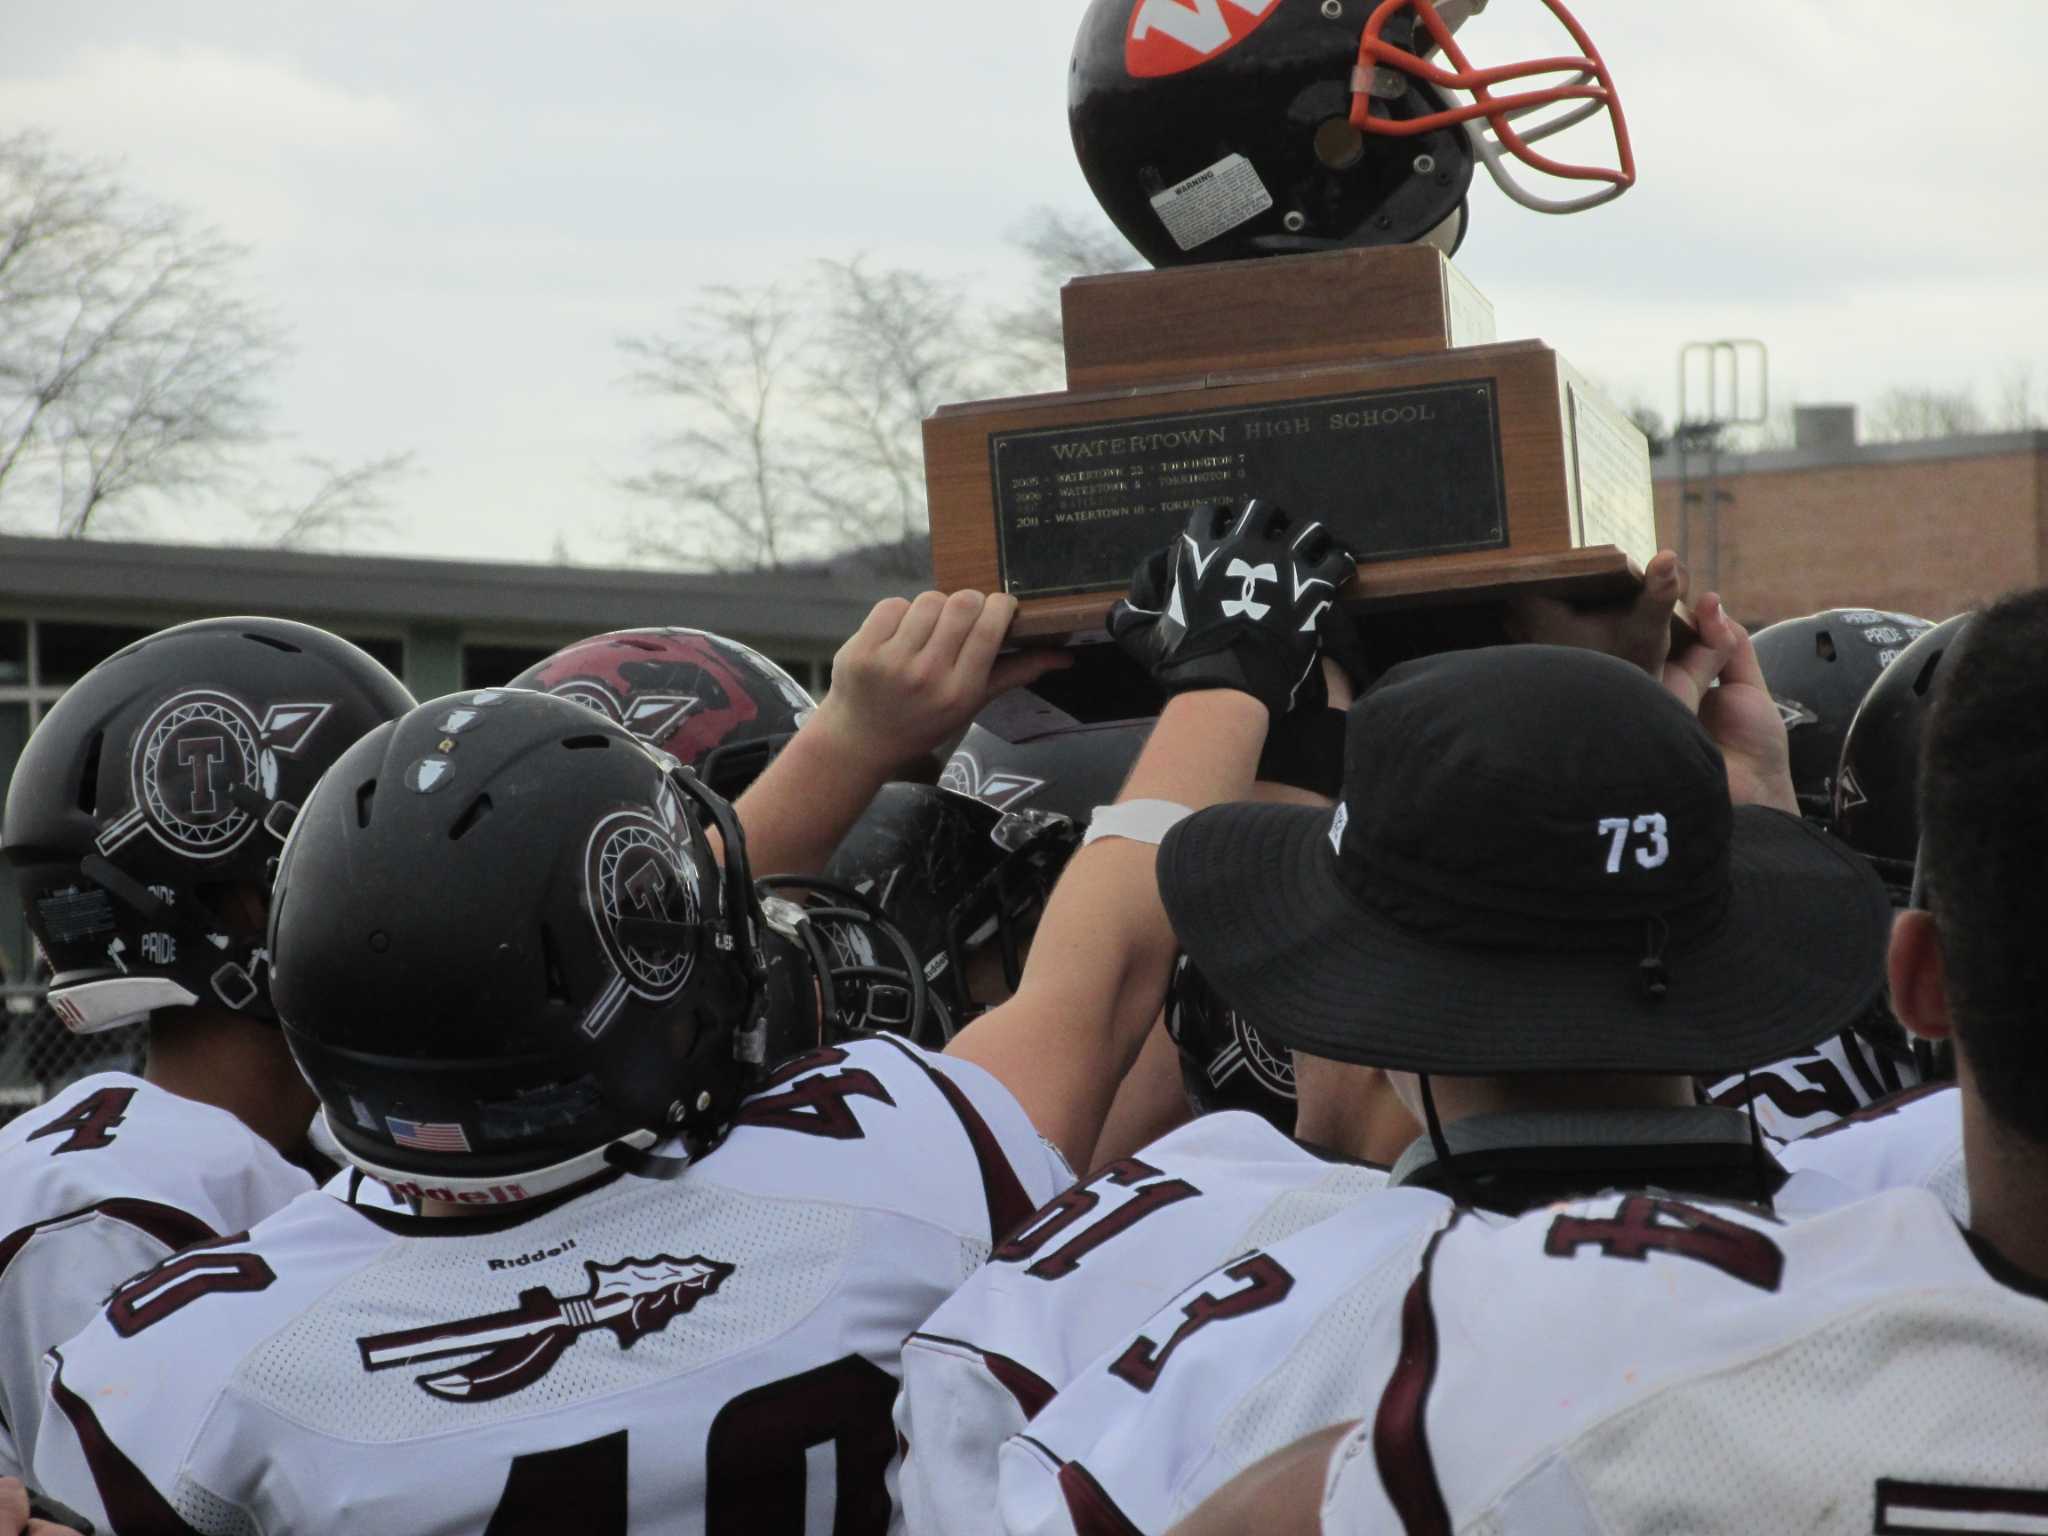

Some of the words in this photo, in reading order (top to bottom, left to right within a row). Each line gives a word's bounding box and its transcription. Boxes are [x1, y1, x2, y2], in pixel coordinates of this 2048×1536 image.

[1174, 170, 1214, 195] WARNING
[1051, 426, 1226, 460] WATERTOWN
[1244, 416, 1312, 440] HIGH
[1329, 404, 1436, 430] SCHOOL
[1055, 507, 1129, 524] WATERTOWN
[178, 736, 224, 814] T
[1598, 811, 1670, 874] 73
[141, 932, 177, 965] PRIDE
[26, 1086, 139, 1156] 4
[487, 1238, 577, 1271] Riddell
